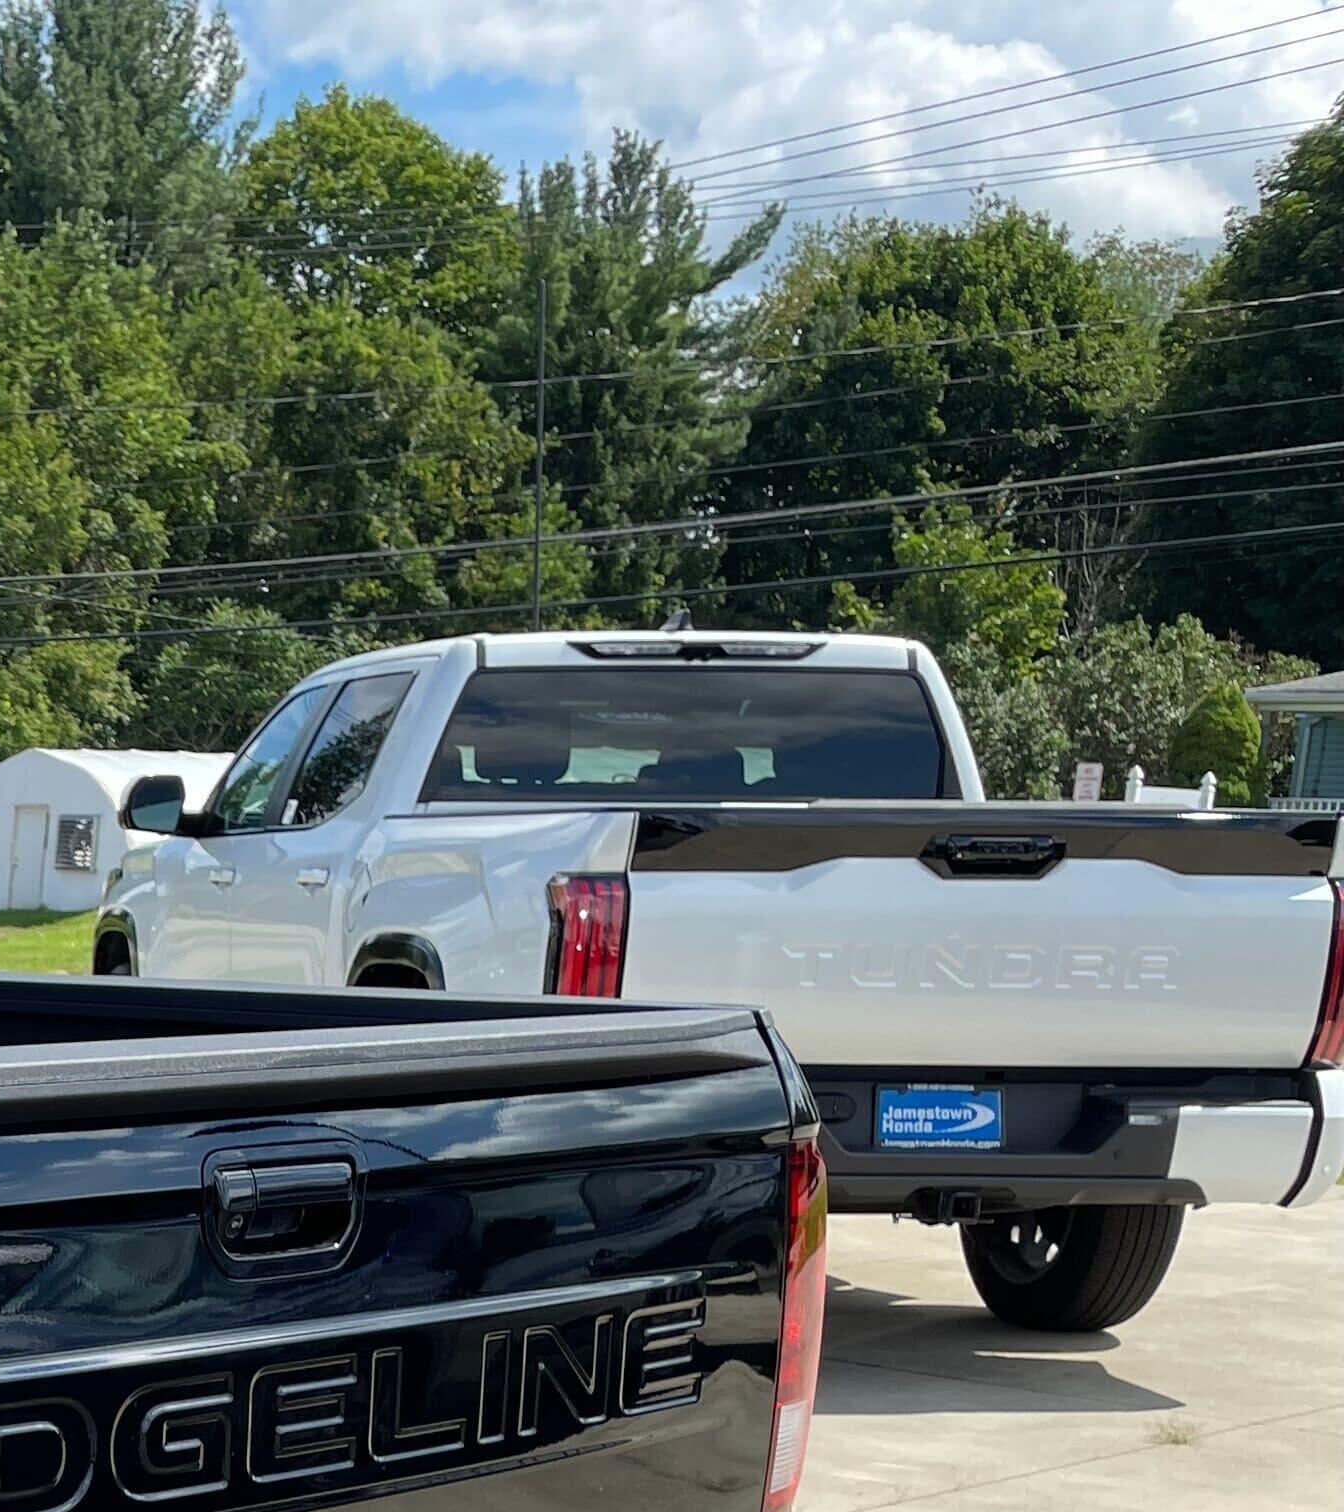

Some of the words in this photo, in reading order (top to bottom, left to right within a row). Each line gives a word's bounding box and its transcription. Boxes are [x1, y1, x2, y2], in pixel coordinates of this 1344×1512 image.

[781, 943, 1182, 990] TUNDRA
[883, 1105, 973, 1121] Jamestown
[882, 1119, 933, 1134] Honda
